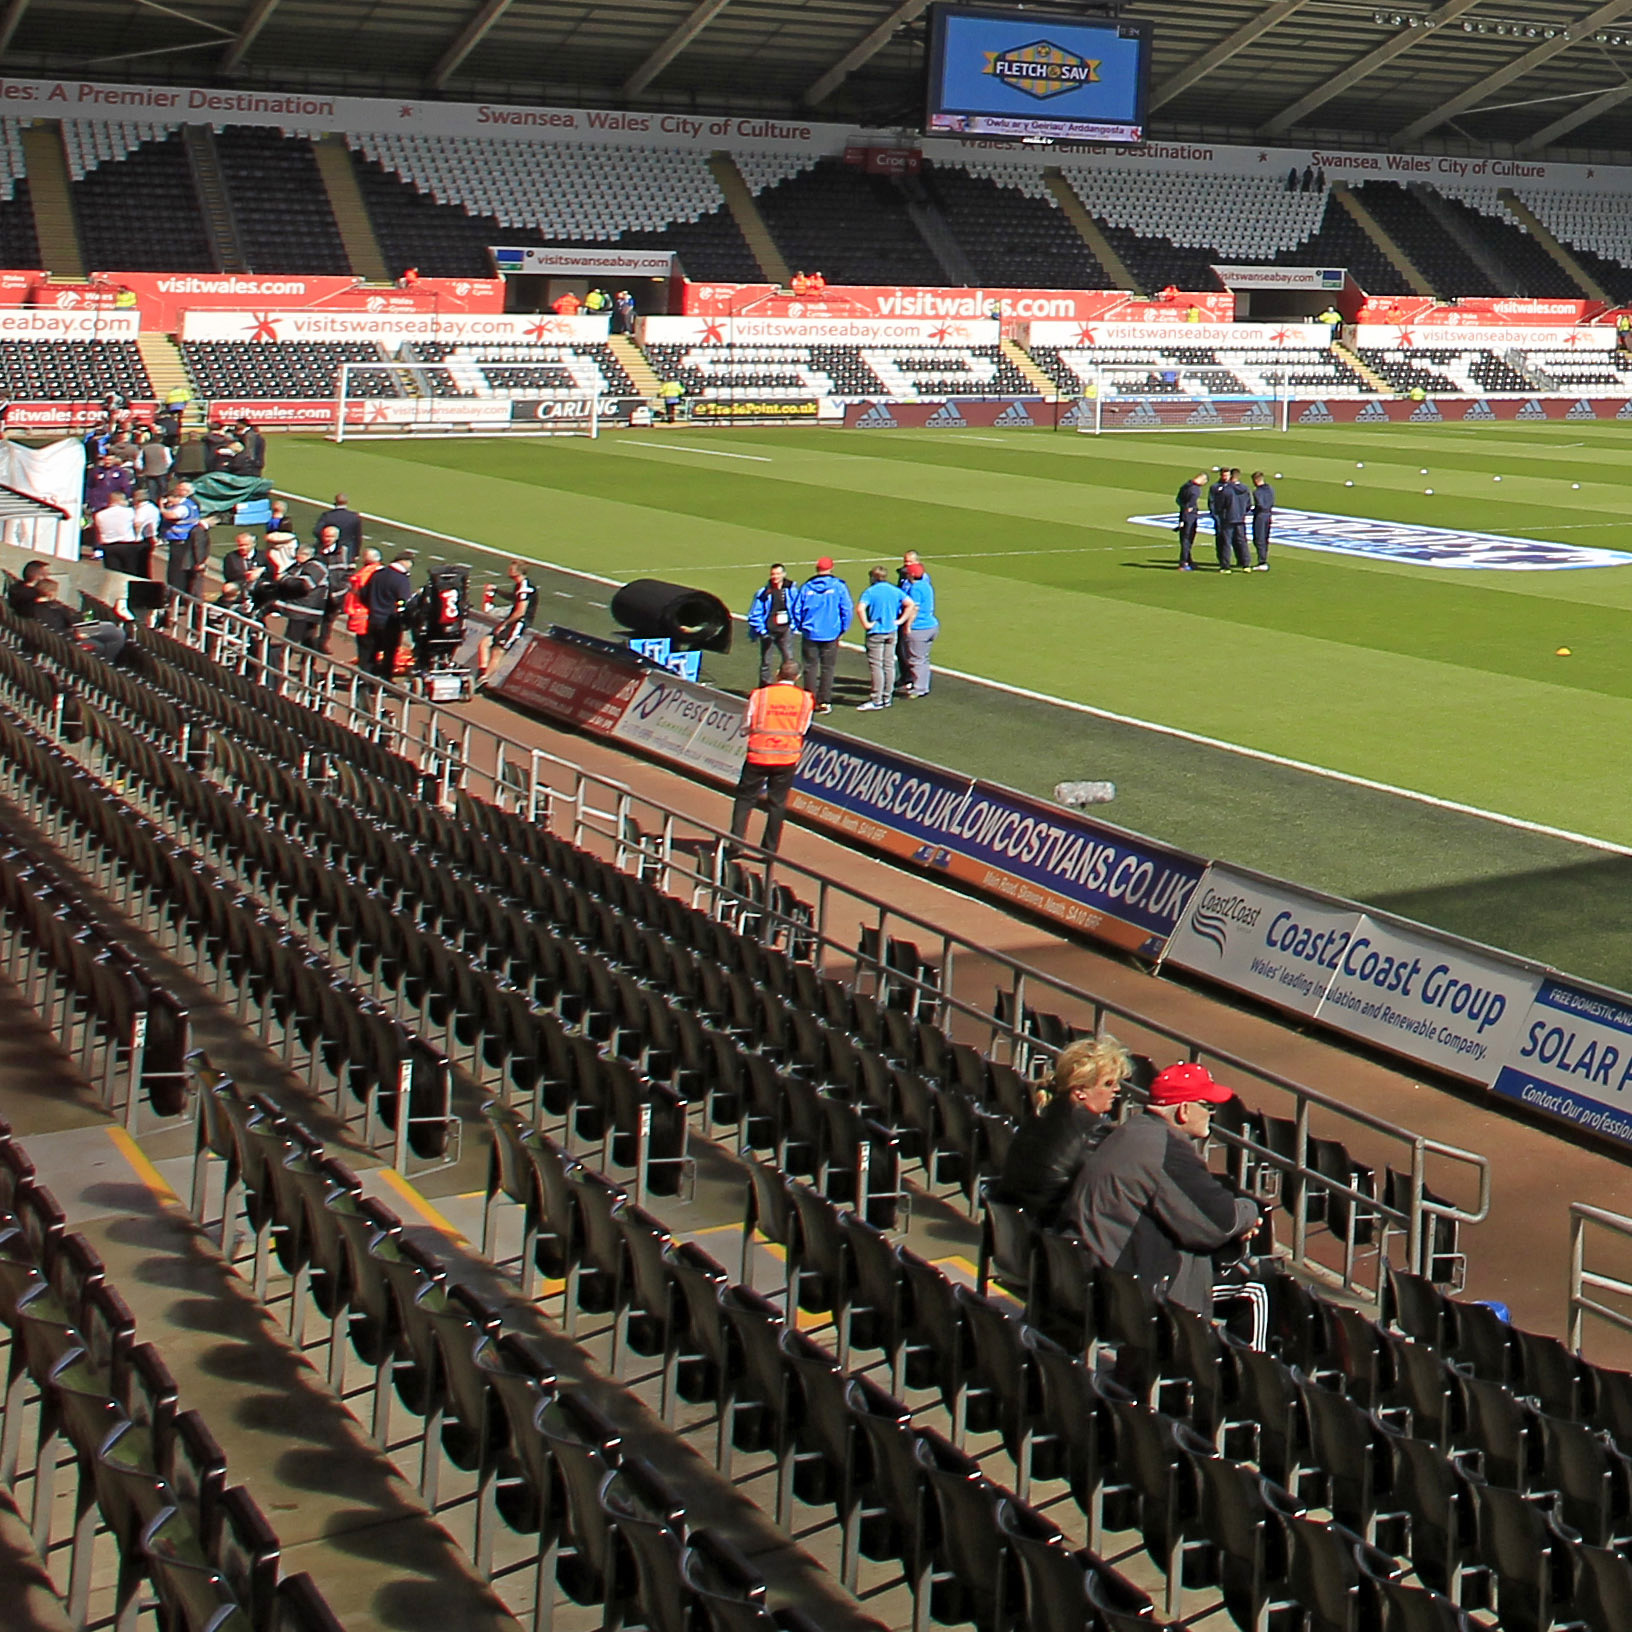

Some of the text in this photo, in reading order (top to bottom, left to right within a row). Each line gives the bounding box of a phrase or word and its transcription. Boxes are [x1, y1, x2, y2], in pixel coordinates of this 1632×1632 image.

[996, 61, 1089, 80] FLETCH SAV
[49, 83, 335, 116] A Premier Destination
[476, 105, 579, 130] Swansea,
[660, 115, 704, 139] City
[709, 118, 732, 136] of
[736, 119, 812, 140] Culture
[1311, 151, 1381, 171] Swansea,
[1438, 158, 1470, 178] City
[1472, 159, 1489, 175] of
[1491, 160, 1546, 179] Culture
[537, 254, 669, 269] visitswanseabay.com
[157, 277, 305, 296] visitwales.com
[877, 290, 1076, 318] visitwales.com
[1492, 300, 1577, 316] visitwales.com
[293, 317, 515, 339] visitswanseabay.com
[736, 322, 920, 340] visitswanseabay.com
[1106, 325, 1263, 343] visitswanseabay.com
[1422, 329, 1558, 345] visitswanseabay.com
[218, 405, 331, 421] visitwales.com
[666, 688, 736, 733] Prescott
[796, 739, 963, 832] WCOSTVANS.CO.UK
[950, 796, 1198, 921] LOWCOSTVANS.CO.UK
[1200, 887, 1262, 927] Coast2Coast
[1265, 910, 1508, 1034] Coast2Coast Group
[1250, 957, 1488, 1059] Wales' leading Insulation and Renewable Company,
[1549, 988, 1573, 1008] FREE
[1572, 994, 1615, 1020] DOMESTIC
[1519, 1020, 1620, 1087] SOLAR
[1521, 1083, 1562, 1112] Contact
[1561, 1098, 1581, 1119] Our
